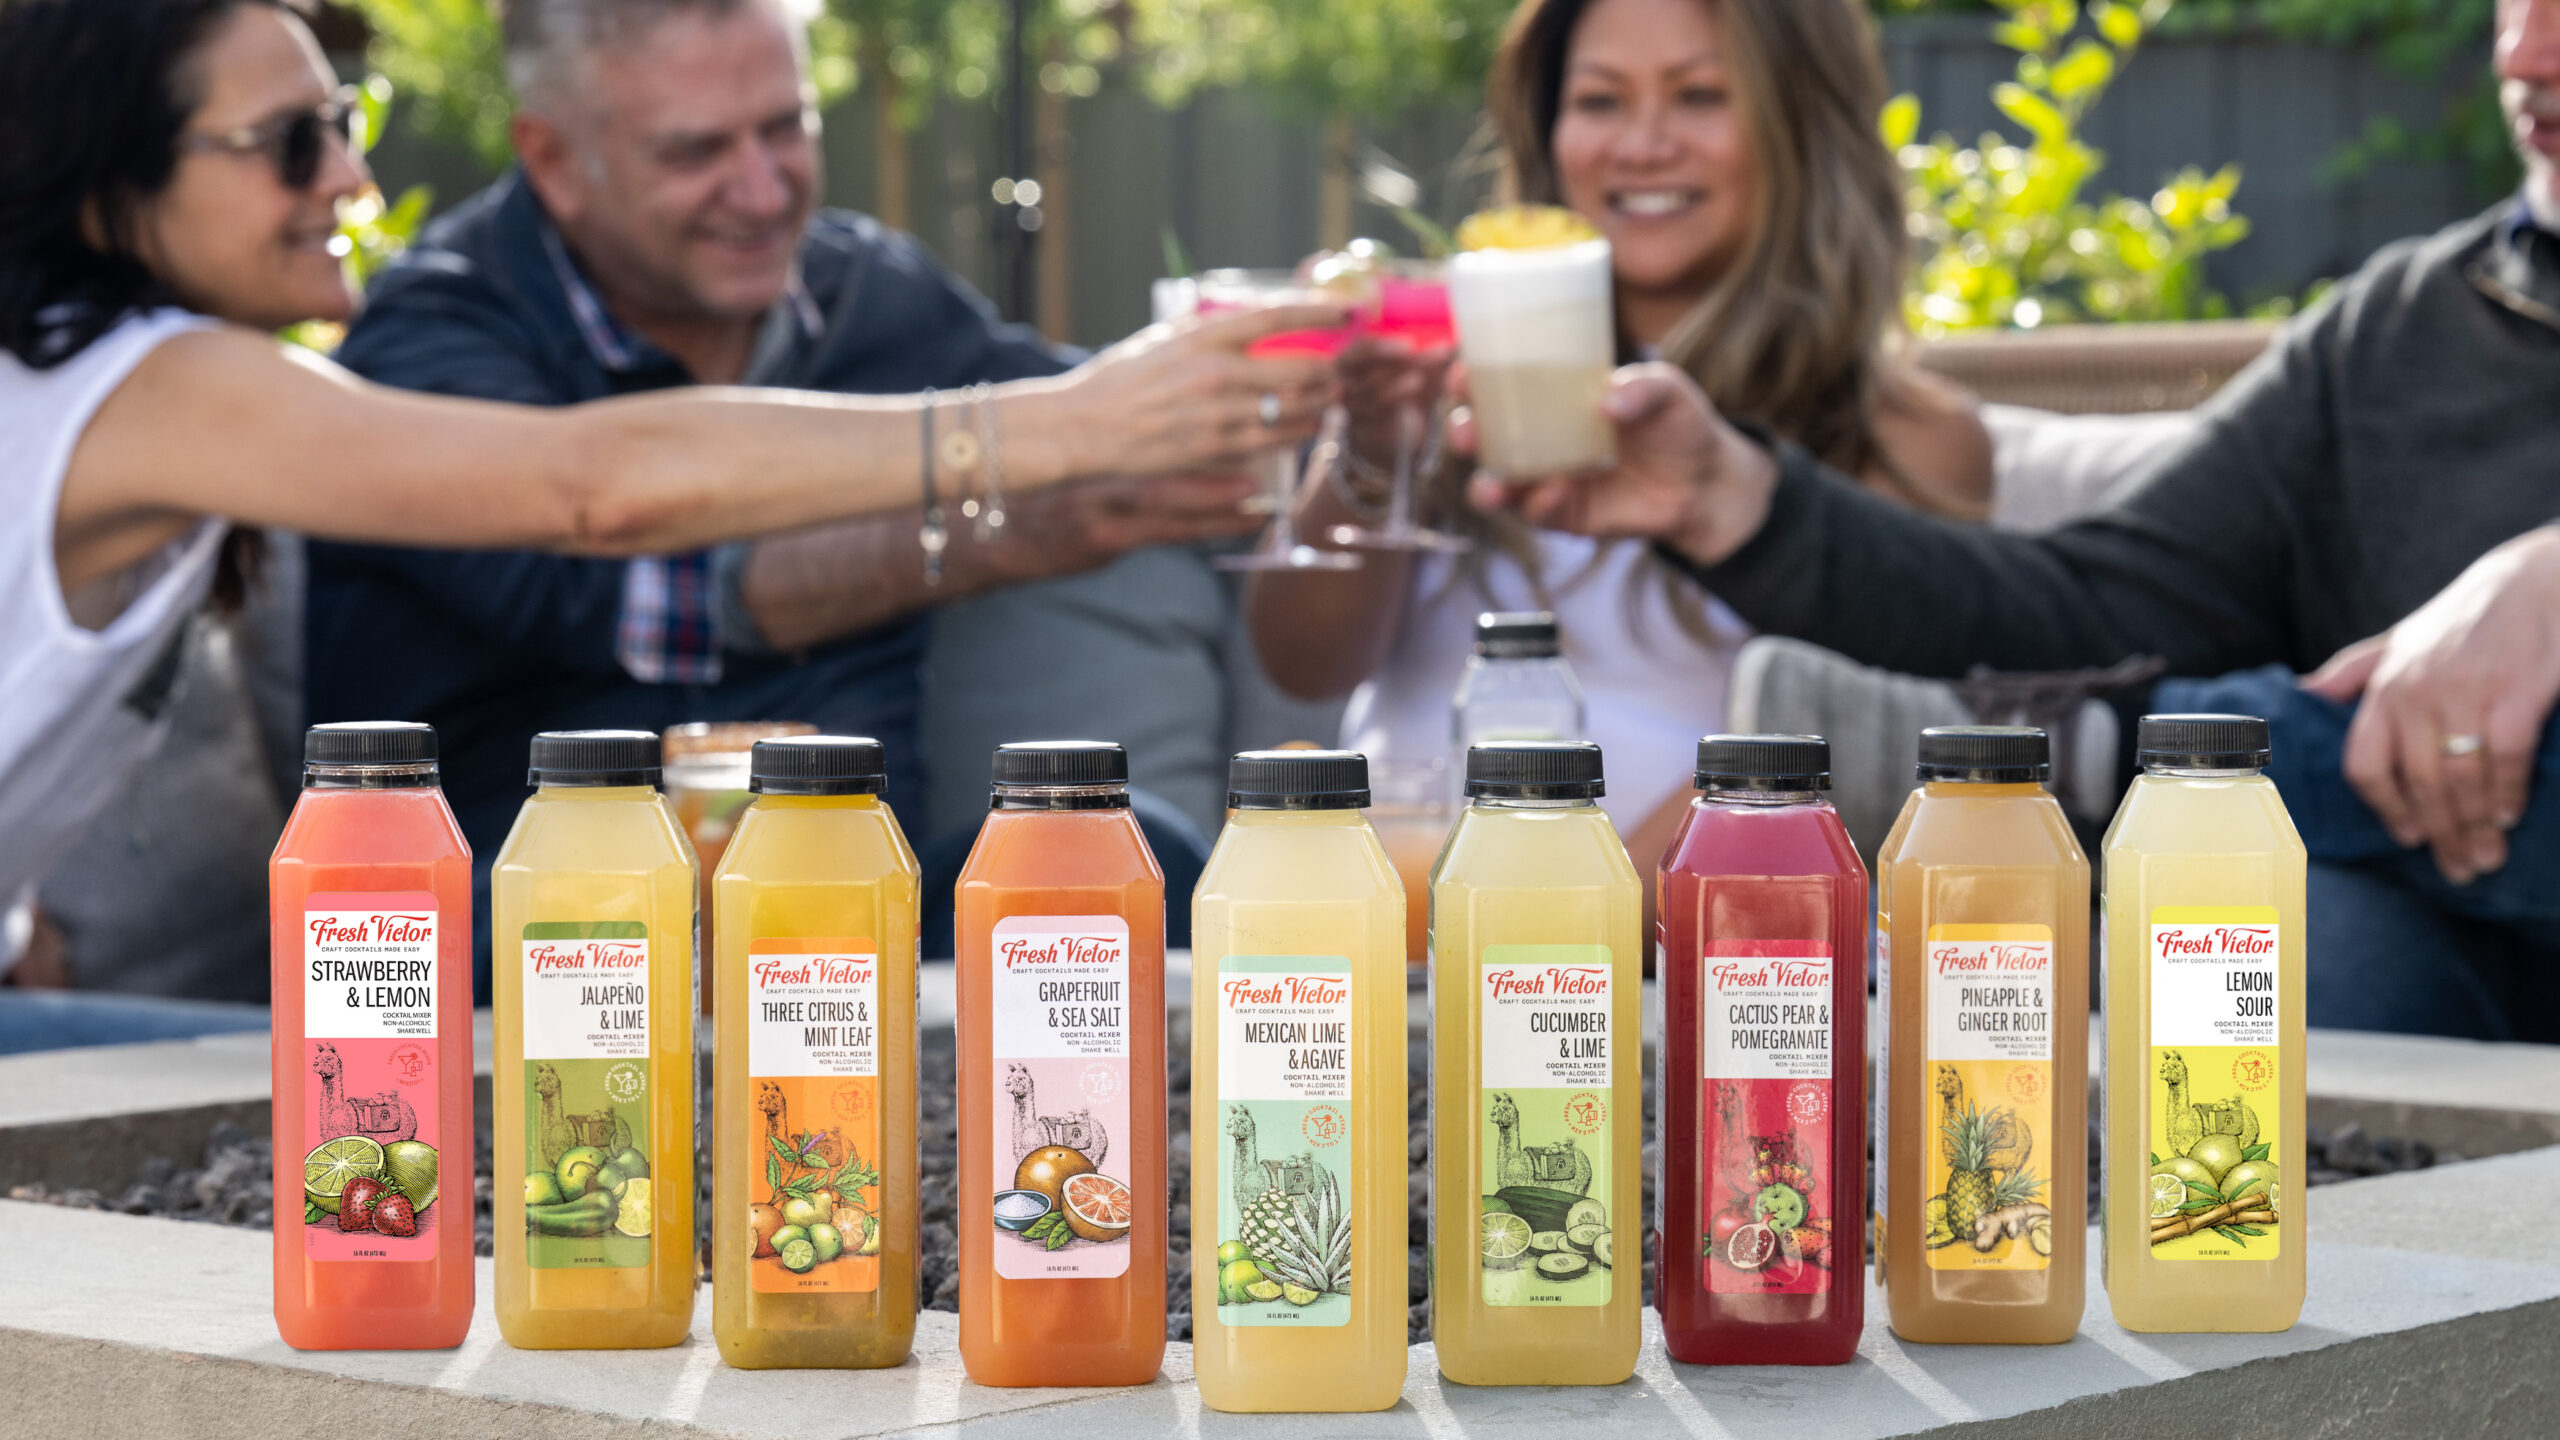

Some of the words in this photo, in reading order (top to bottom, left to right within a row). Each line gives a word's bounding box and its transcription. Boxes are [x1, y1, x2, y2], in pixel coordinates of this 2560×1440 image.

[310, 917, 368, 948] Fresh
[370, 915, 432, 943] Victor
[1001, 940, 1058, 970] Fresh
[1060, 937, 1120, 964] Victor
[2157, 930, 2213, 959] Fresh
[2215, 928, 2274, 954] Victor
[530, 945, 584, 974] Fresh
[587, 943, 644, 968] Victor
[1934, 947, 1988, 975] Fresh
[1990, 945, 2047, 970] Victor
[312, 960, 432, 981] STRAWBERRY
[754, 960, 811, 990] Fresh
[813, 958, 872, 984] Victor
[1712, 963, 1768, 992] Fresh
[1770, 961, 1829, 987] Victor
[1488, 970, 1544, 1000] Fresh
[1547, 968, 1607, 994] Victor
[2226, 972, 2272, 991] LEMON
[346, 987, 360, 1008] &
[366, 987, 430, 1008] LEMON
[580, 982, 644, 1006] JALAPEÑO
[1039, 982, 1120, 1002] GRAPEFRUIT
[1224, 979, 1282, 1009] Fresh
[1284, 977, 1346, 1004] Victor
[1961, 988, 2029, 1007] PINEAPPLE
[2033, 988, 2043, 1007] &
[762, 1002, 804, 1022] THREE
[808, 1002, 854, 1022] CITRUS
[858, 1002, 868, 1022] &
[1730, 1004, 1778, 1024] CACTUS
[1783, 1005, 1815, 1024] PEAR
[1820, 1004, 1829, 1024] &
[2236, 996, 2273, 1016] SOUR
[600, 1010, 610, 1029] &
[614, 1010, 645, 1029] LIME
[1048, 1008, 1058, 1027] &
[1062, 1007, 1086, 1027] SEA
[1091, 1007, 1121, 1027] SALT
[1531, 1012, 1606, 1032] CUCUMBER
[1958, 1012, 2008, 1032] GINGER
[2014, 1012, 2047, 1032] ROOT
[804, 1027, 837, 1046] MINT
[842, 1027, 872, 1046] LEAF
[1245, 1023, 1306, 1043] MEXICAN
[1313, 1023, 1346, 1043] LIME
[1732, 1029, 1828, 1049] POMEGRANATE
[1560, 1038, 1570, 1058] &
[1574, 1038, 1606, 1058] LIME
[1288, 1048, 1299, 1070] &
[1301, 1048, 1346, 1069] AGAVE
